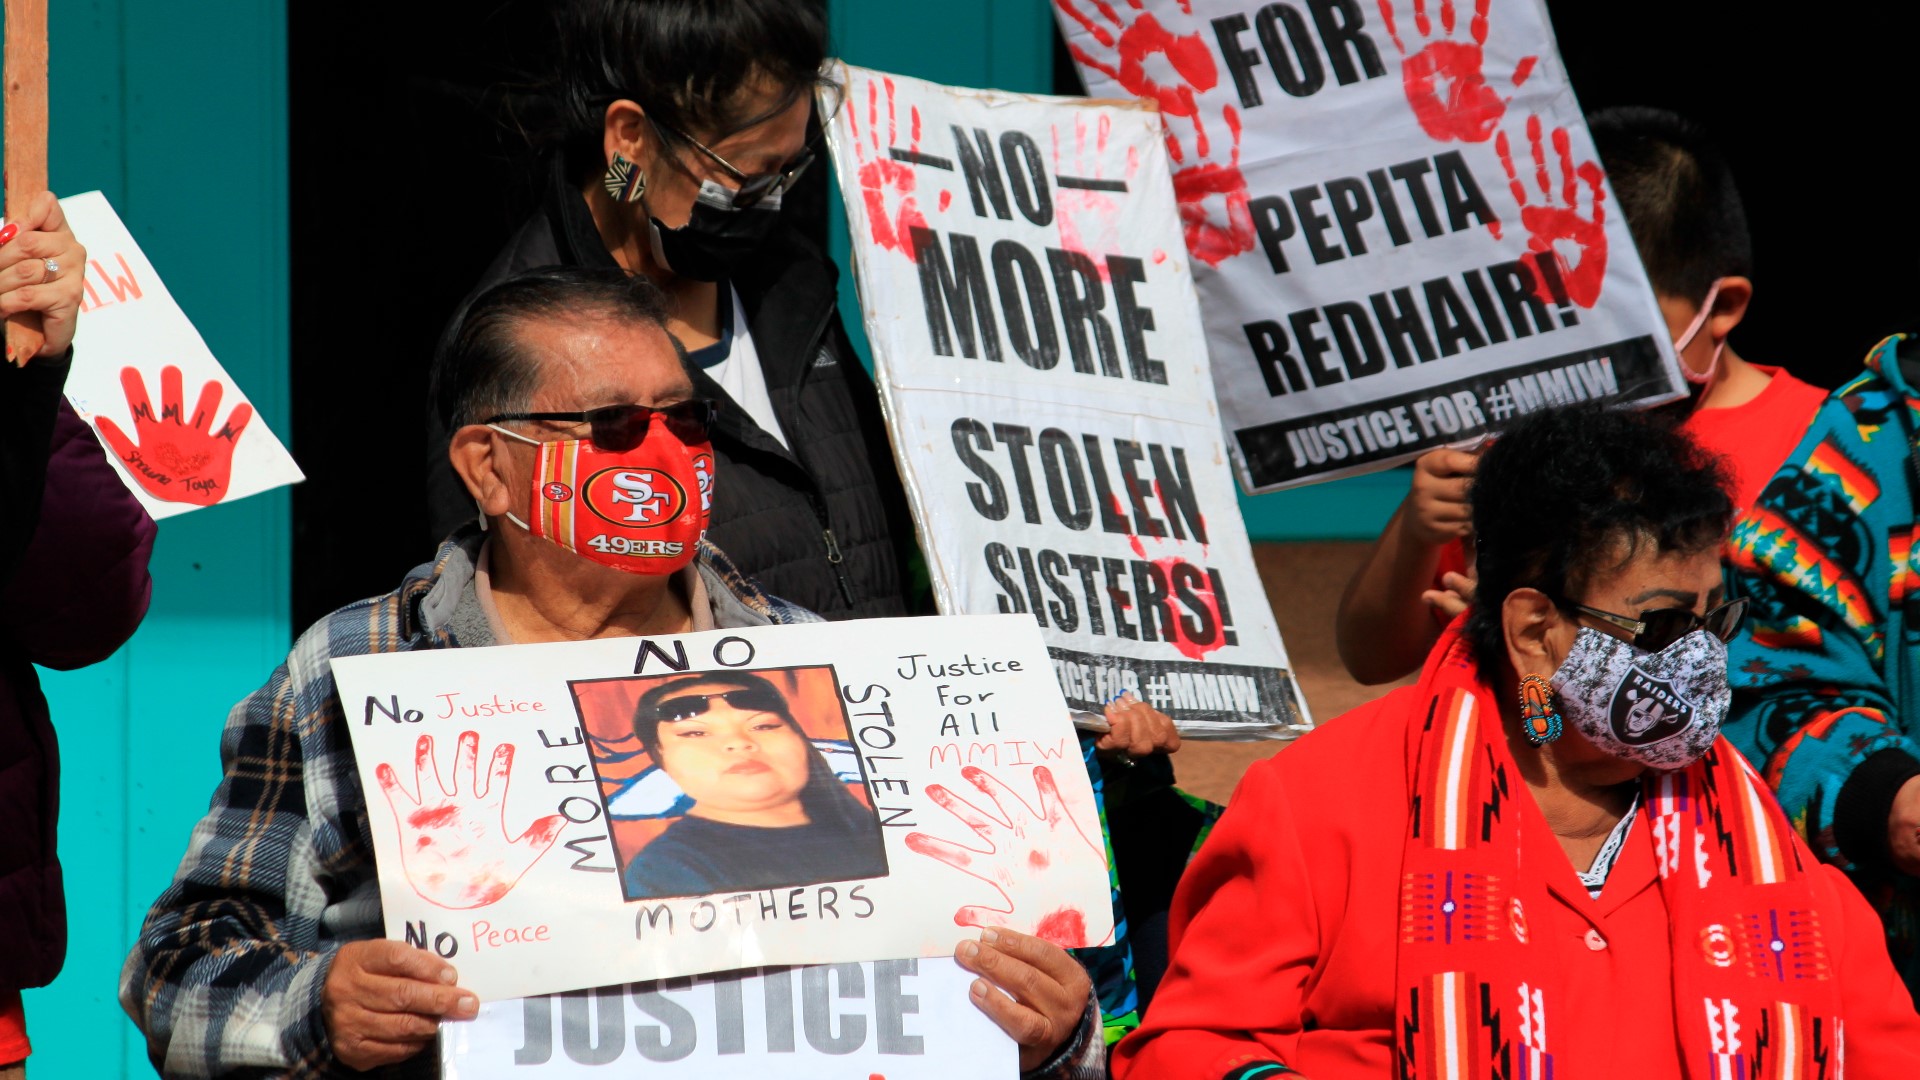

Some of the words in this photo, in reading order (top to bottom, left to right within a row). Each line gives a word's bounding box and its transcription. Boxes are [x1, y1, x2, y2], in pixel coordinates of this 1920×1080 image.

[1211, 0, 1388, 109] FOR
[949, 124, 1054, 227] NO
[1246, 150, 1499, 275] PEPITA
[80, 252, 143, 313] IW
[909, 225, 1168, 386] MORE
[1243, 251, 1580, 398] REDHAIR!
[1286, 406, 1419, 468] JUSTICE
[1413, 390, 1486, 439] FOR
[1486, 356, 1618, 421] #MMIW
[612, 472, 670, 522] SF
[951, 418, 1209, 544] STOLEN
[587, 534, 683, 556] 49ERS
[984, 541, 1239, 648] SISTERS!
[634, 636, 755, 674] NO
[897, 654, 1024, 681] Justice
[364, 695, 423, 725] No
[435, 692, 547, 720] Justice
[936, 684, 995, 707] For
[1094, 666, 1143, 704] FOR
[1146, 672, 1260, 713] #MMIW
[1633, 674, 1688, 714] RAIDERS
[929, 738, 1065, 769] MMIW
[940, 712, 1000, 737] All
[843, 683, 917, 828] STOLEN
[537, 727, 616, 874] MORE
[471, 920, 551, 951] Peace
[635, 884, 874, 940] MOTHERS
[514, 958, 925, 1066] JUSTICE
